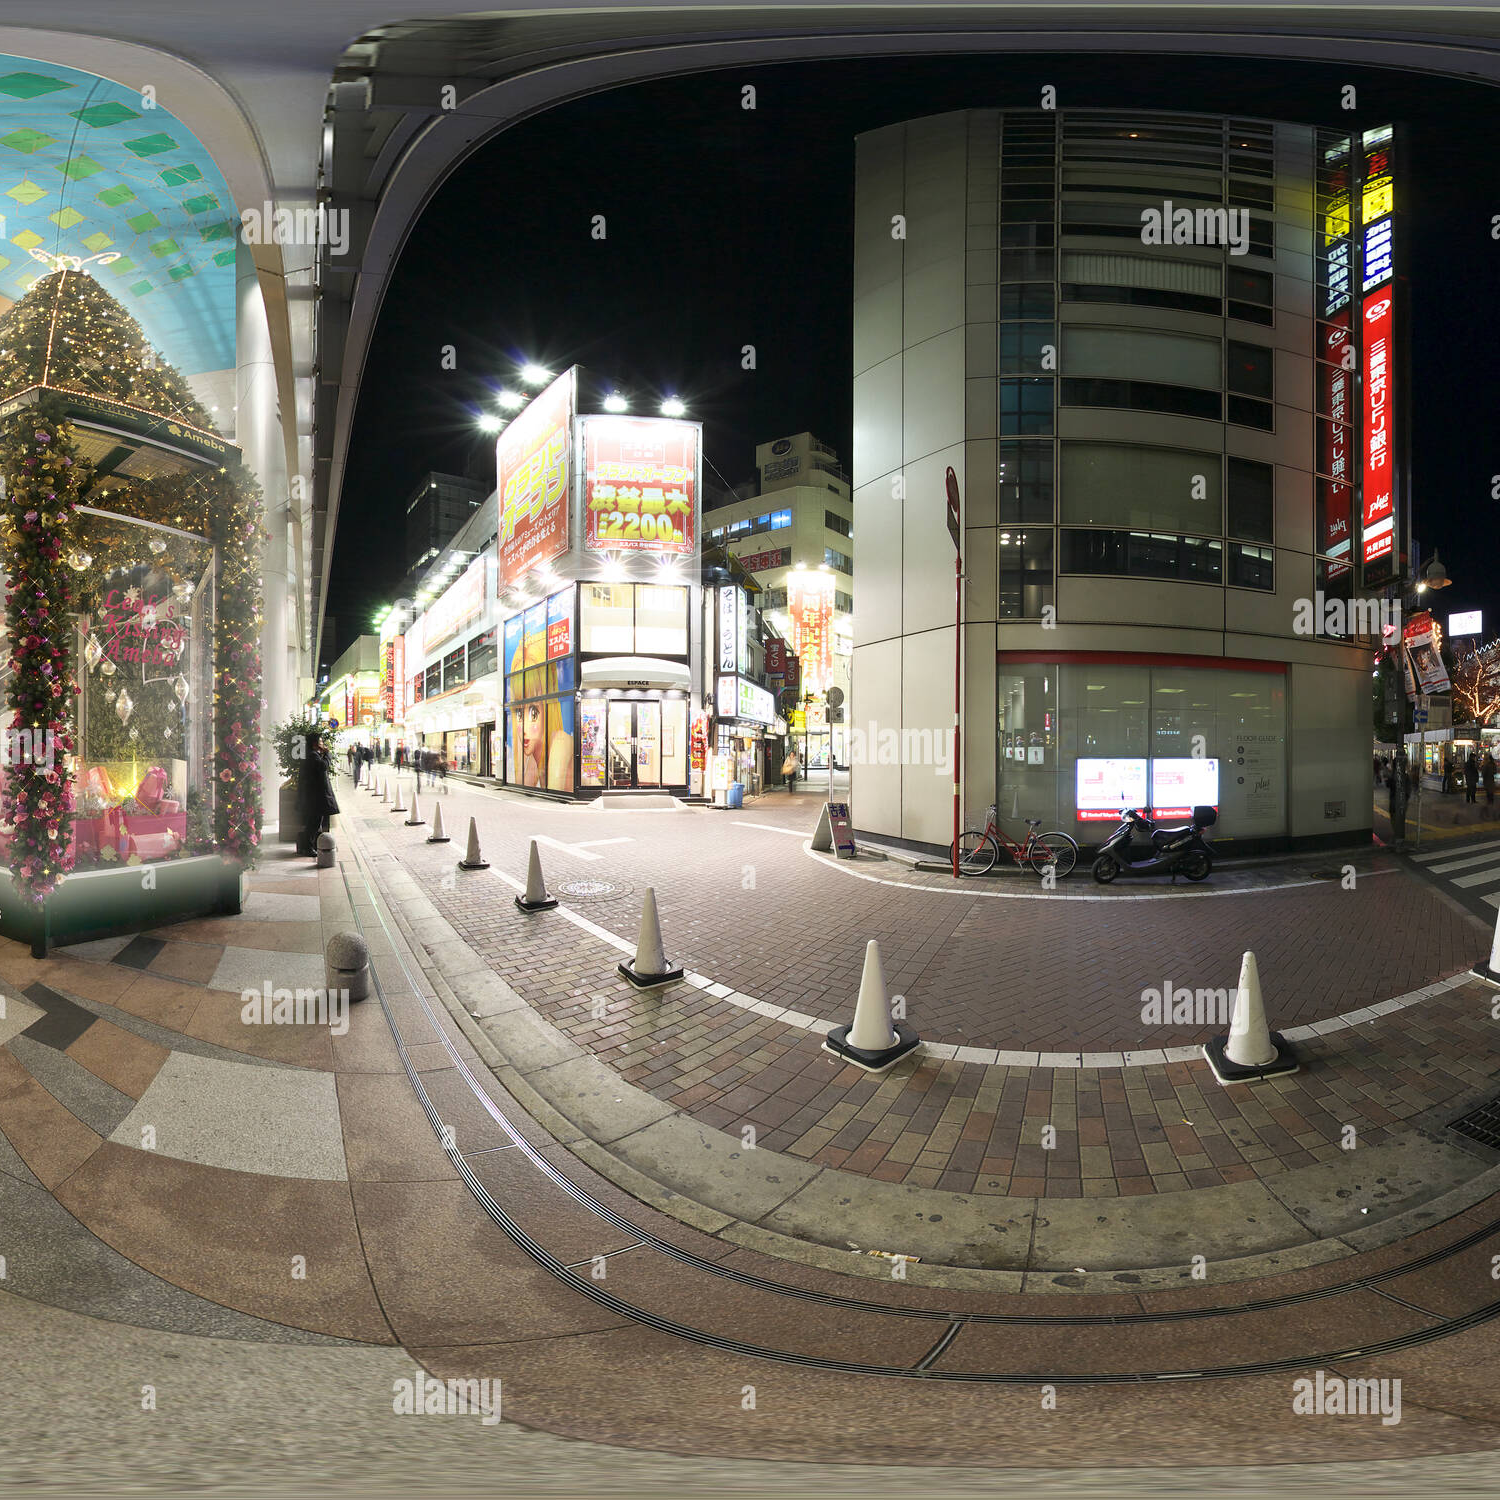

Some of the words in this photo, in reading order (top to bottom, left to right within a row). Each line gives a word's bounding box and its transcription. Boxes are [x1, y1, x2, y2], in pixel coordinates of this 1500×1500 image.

[183, 431, 226, 453] Ameba
[1368, 492, 1389, 520] plus
[100, 639, 175, 666] Ameba
